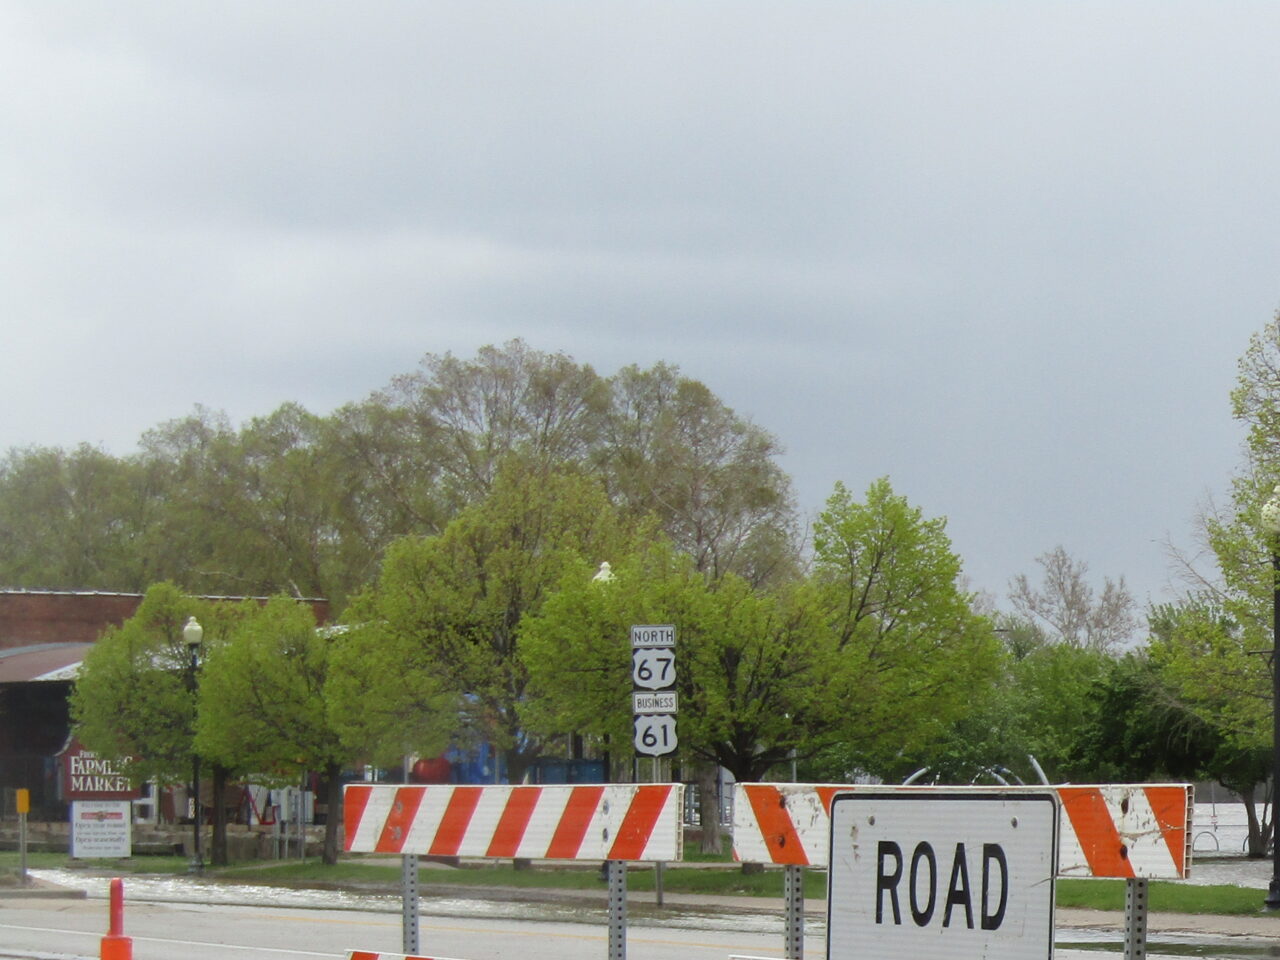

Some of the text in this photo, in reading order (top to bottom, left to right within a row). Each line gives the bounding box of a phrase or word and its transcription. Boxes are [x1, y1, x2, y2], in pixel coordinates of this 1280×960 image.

[634, 630, 674, 642] NORTH
[638, 658, 672, 681] 67
[637, 697, 674, 709] BUSINESS
[642, 724, 668, 747] 61
[71, 776, 132, 792] MARKET
[875, 840, 1009, 931] ROAD
